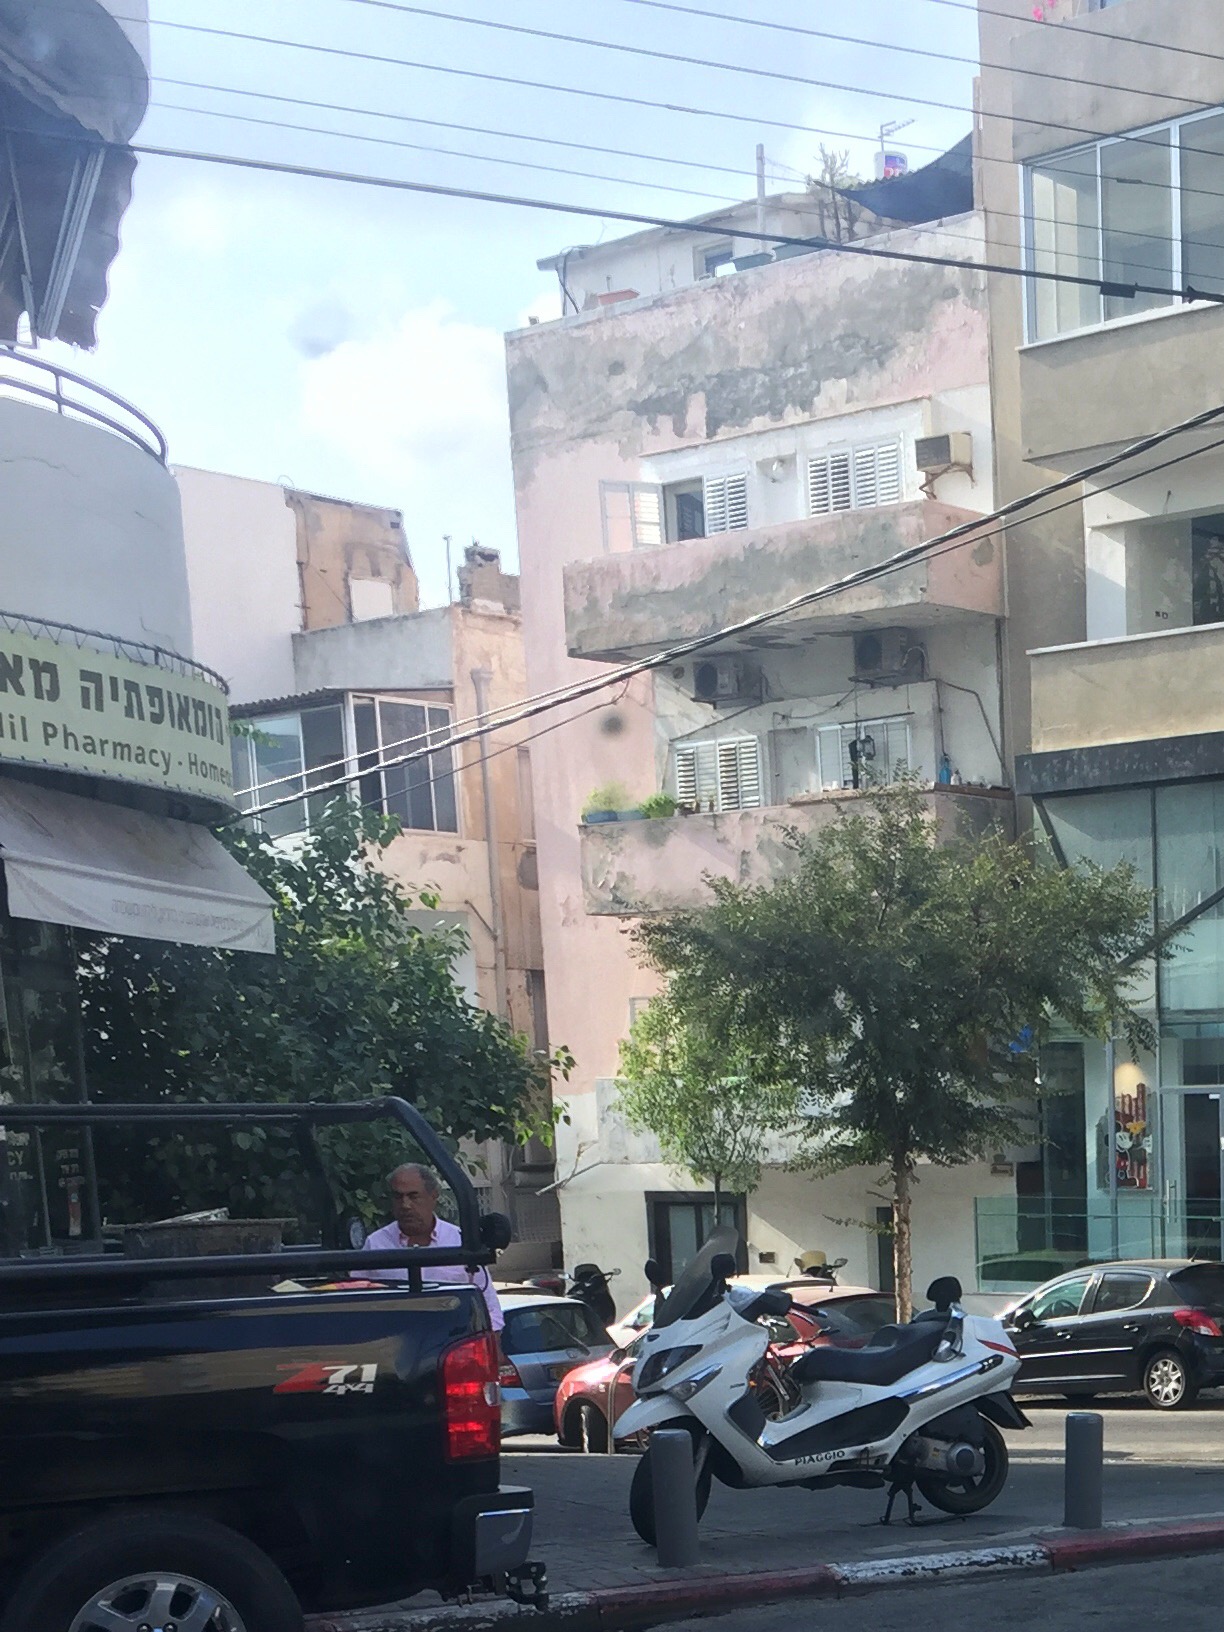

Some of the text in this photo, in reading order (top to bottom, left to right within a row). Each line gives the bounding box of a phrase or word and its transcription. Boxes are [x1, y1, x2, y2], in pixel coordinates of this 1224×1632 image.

[79, 669, 224, 746] הומאופתיה
[42, 721, 172, 776] Pharmacy
[273, 1361, 378, 1395] Z71
[795, 1450, 846, 1466] PIAGGIO
